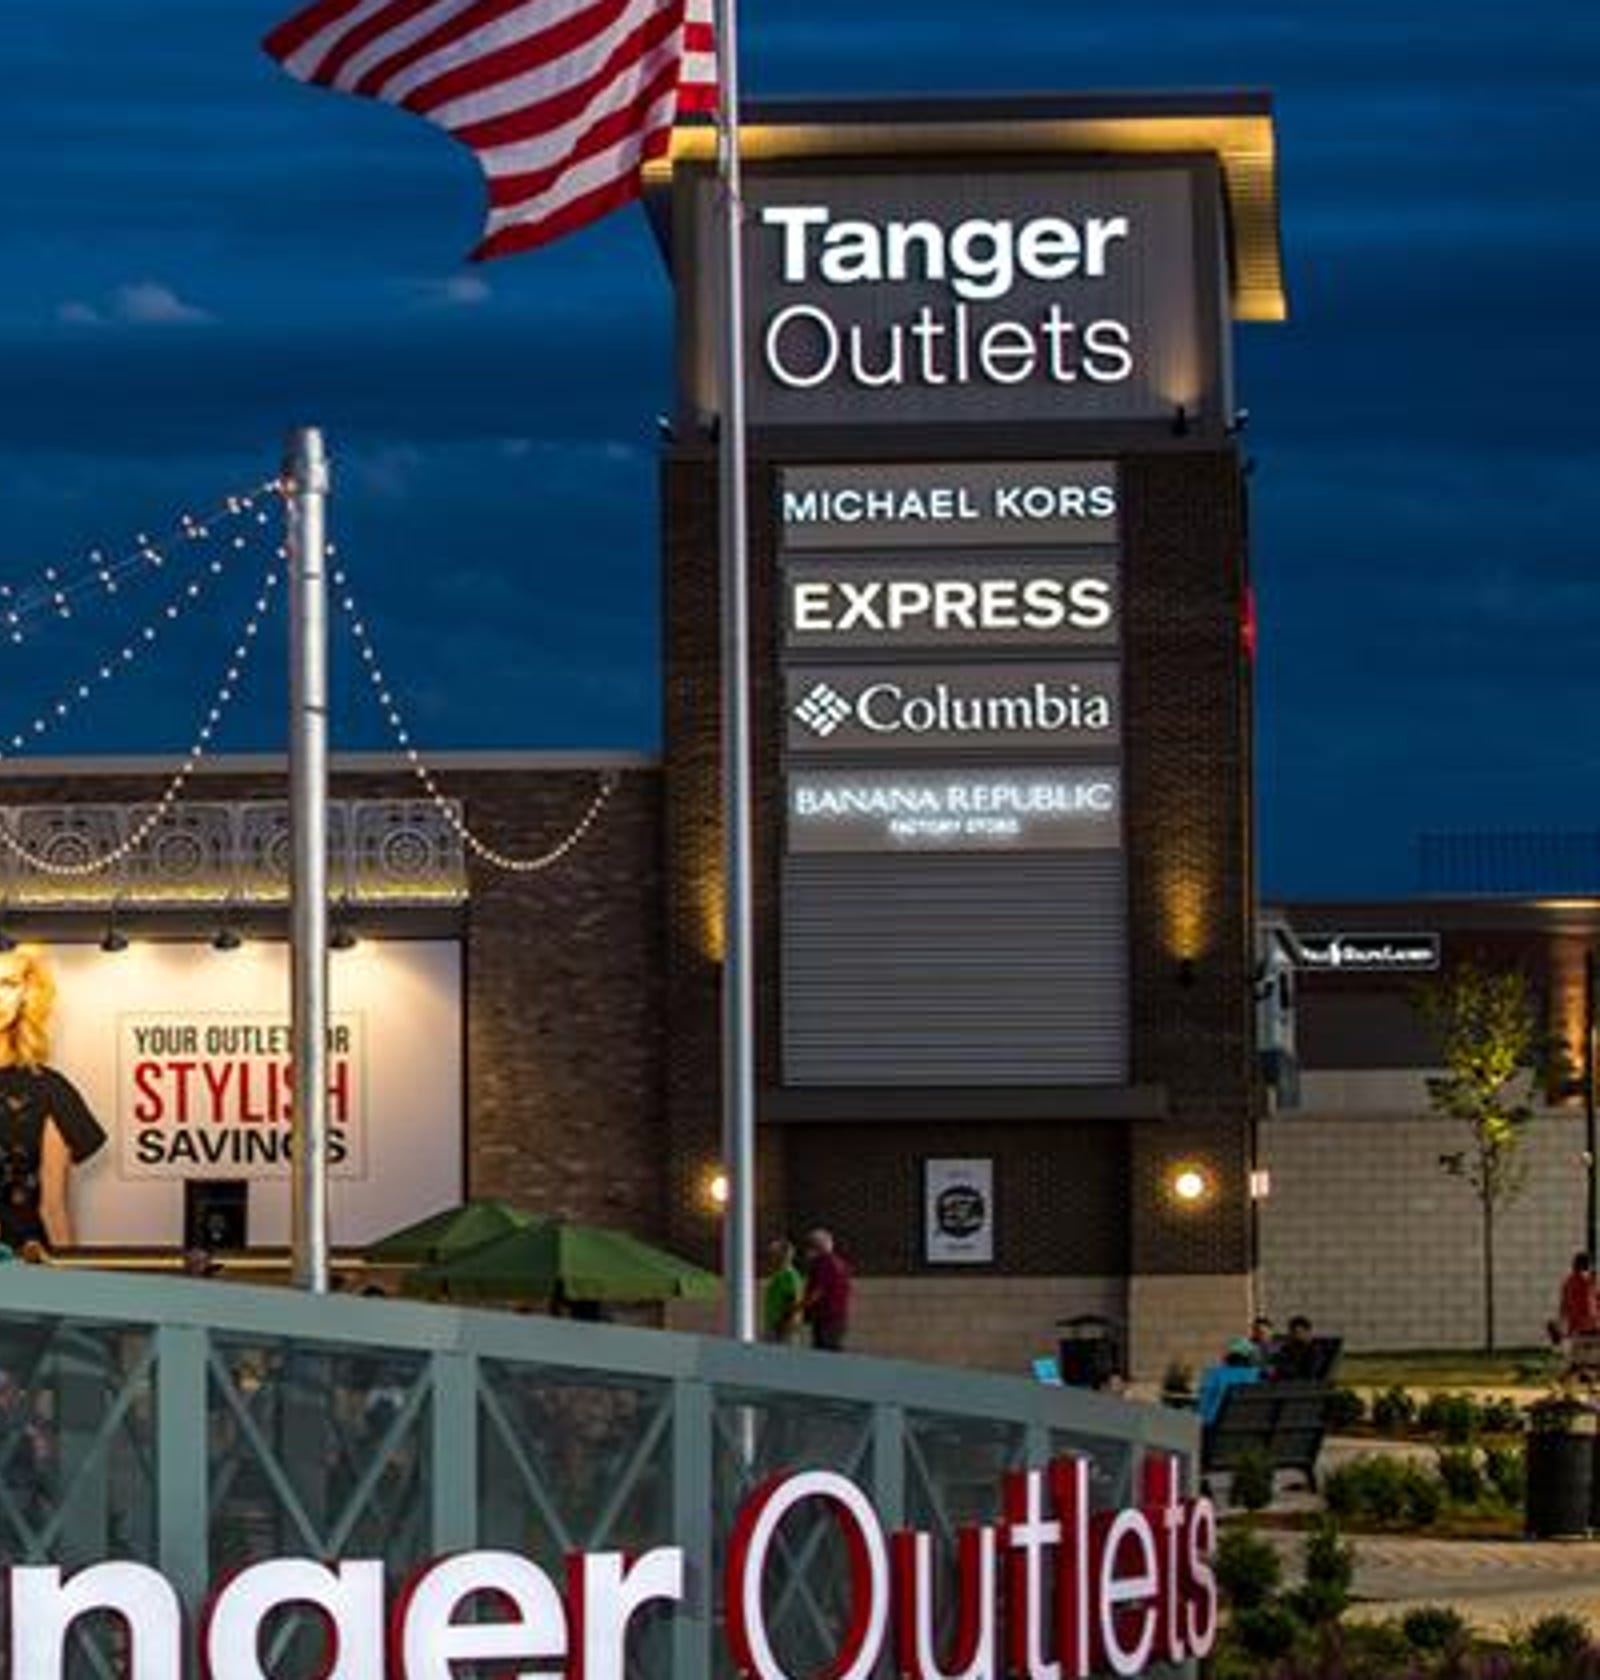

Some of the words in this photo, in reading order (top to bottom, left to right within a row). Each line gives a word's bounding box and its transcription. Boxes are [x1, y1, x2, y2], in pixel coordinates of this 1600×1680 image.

[762, 205, 1129, 299] Tanger
[766, 303, 1133, 387] Outlets
[783, 488, 980, 521] MICHAEL
[996, 485, 1117, 518] KORS
[794, 578, 1112, 630] EXPRESS
[856, 682, 1111, 732] Columbia
[795, 786, 941, 815] BANANA
[947, 783, 1113, 812] REPUBLIC
[134, 1025, 198, 1055] YOUR
[726, 1452, 1219, 1680] Outlets
